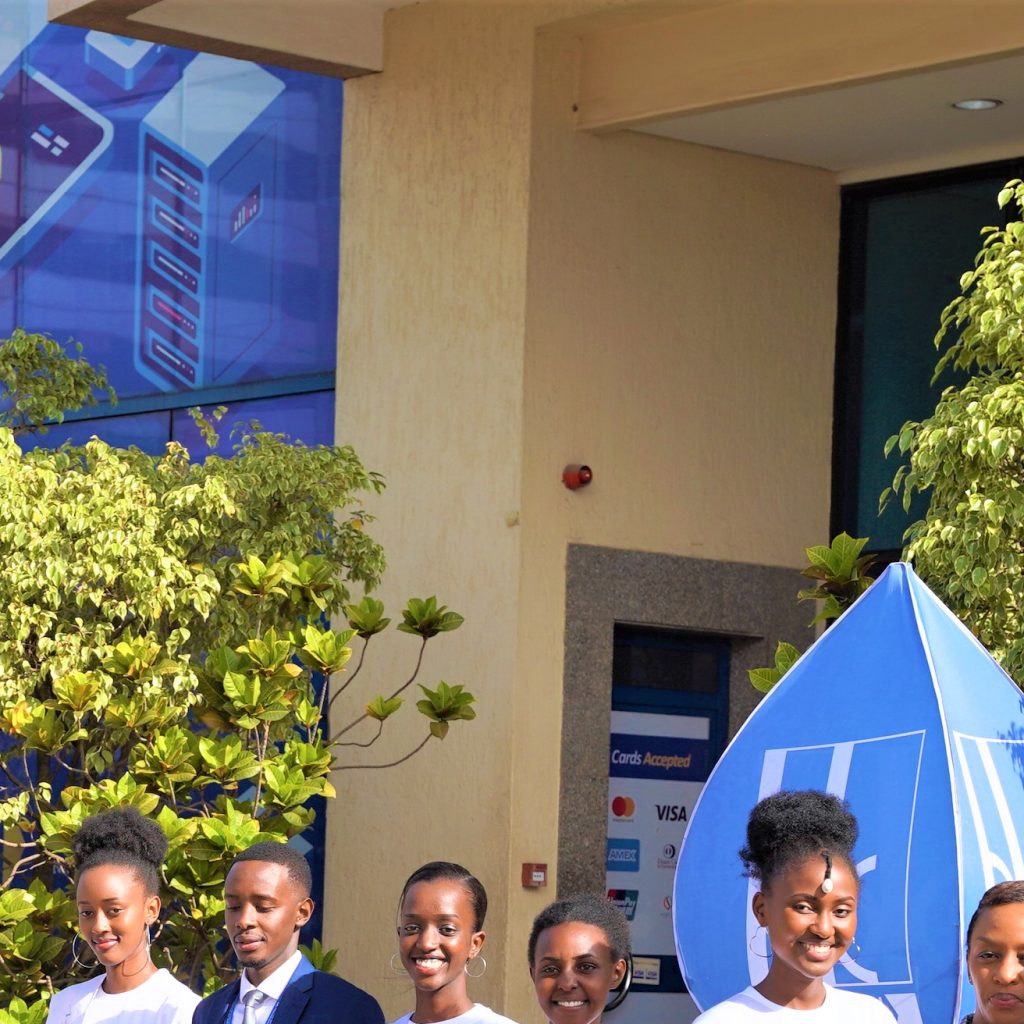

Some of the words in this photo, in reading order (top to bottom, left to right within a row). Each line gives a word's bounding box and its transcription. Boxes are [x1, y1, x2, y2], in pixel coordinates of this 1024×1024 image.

[612, 749, 642, 765] Cards
[643, 751, 692, 770] Accepted
[655, 804, 687, 822] VISA
[607, 848, 637, 862] AMEX
